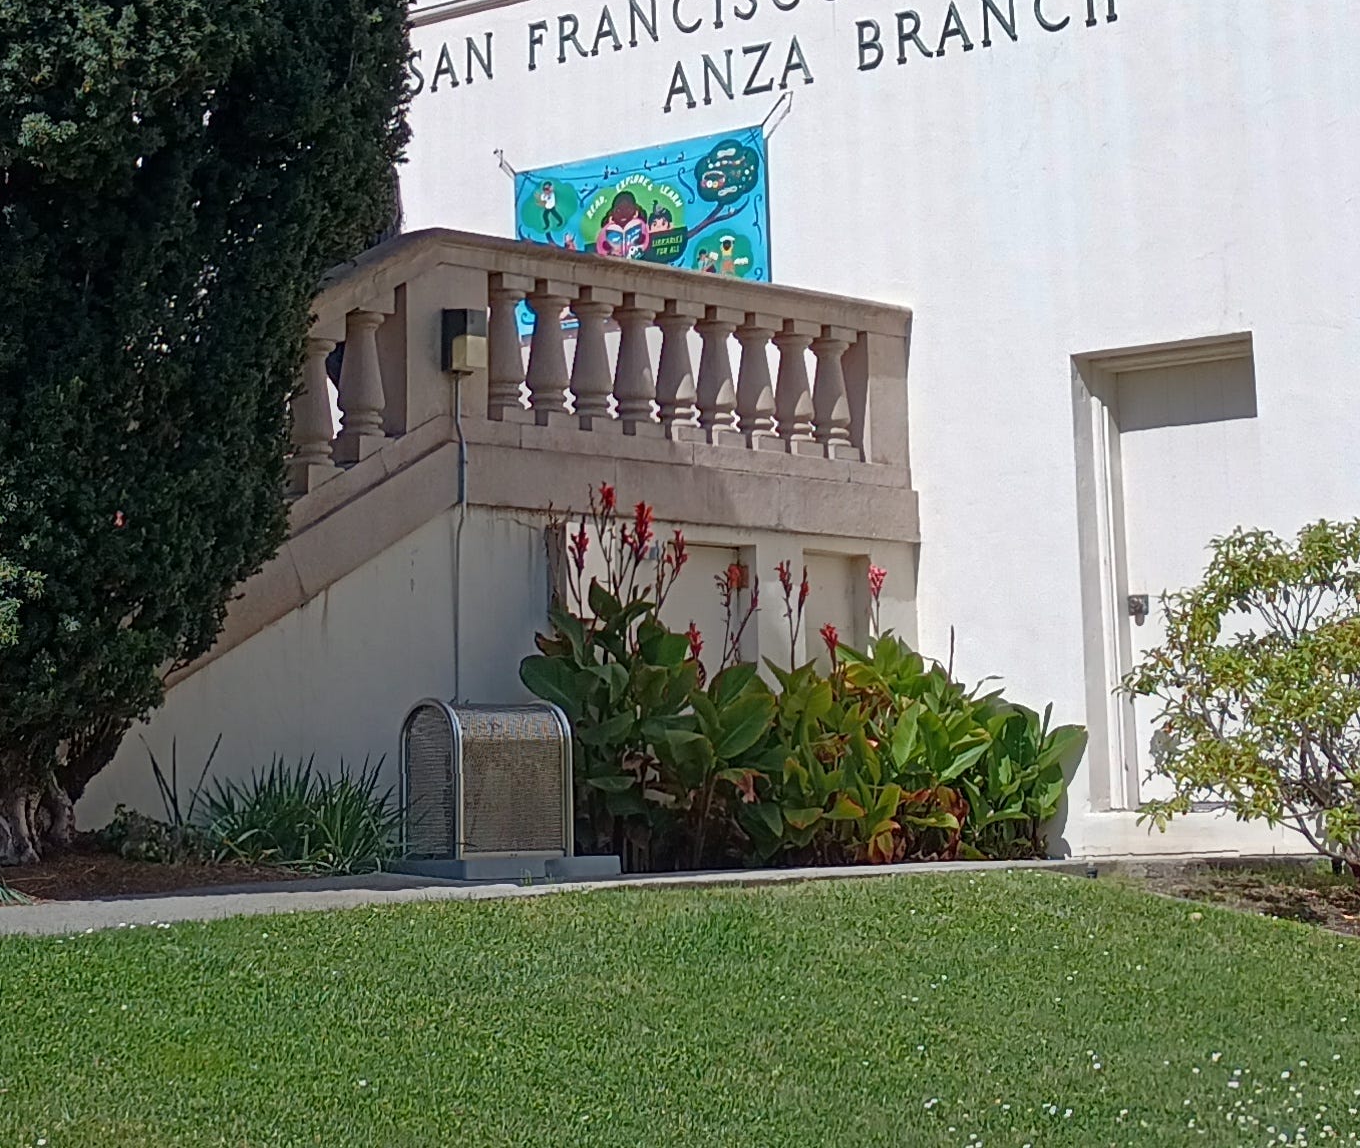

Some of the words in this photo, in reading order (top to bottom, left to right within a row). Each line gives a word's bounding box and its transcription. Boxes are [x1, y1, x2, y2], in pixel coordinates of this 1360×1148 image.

[408, 32, 493, 95] SAN
[663, 34, 814, 113] ANZA
[660, 184, 683, 208] LEARN
[652, 235, 683, 247] LIBRARIES
[656, 246, 668, 256] FOR
[669, 244, 680, 254] ALL
